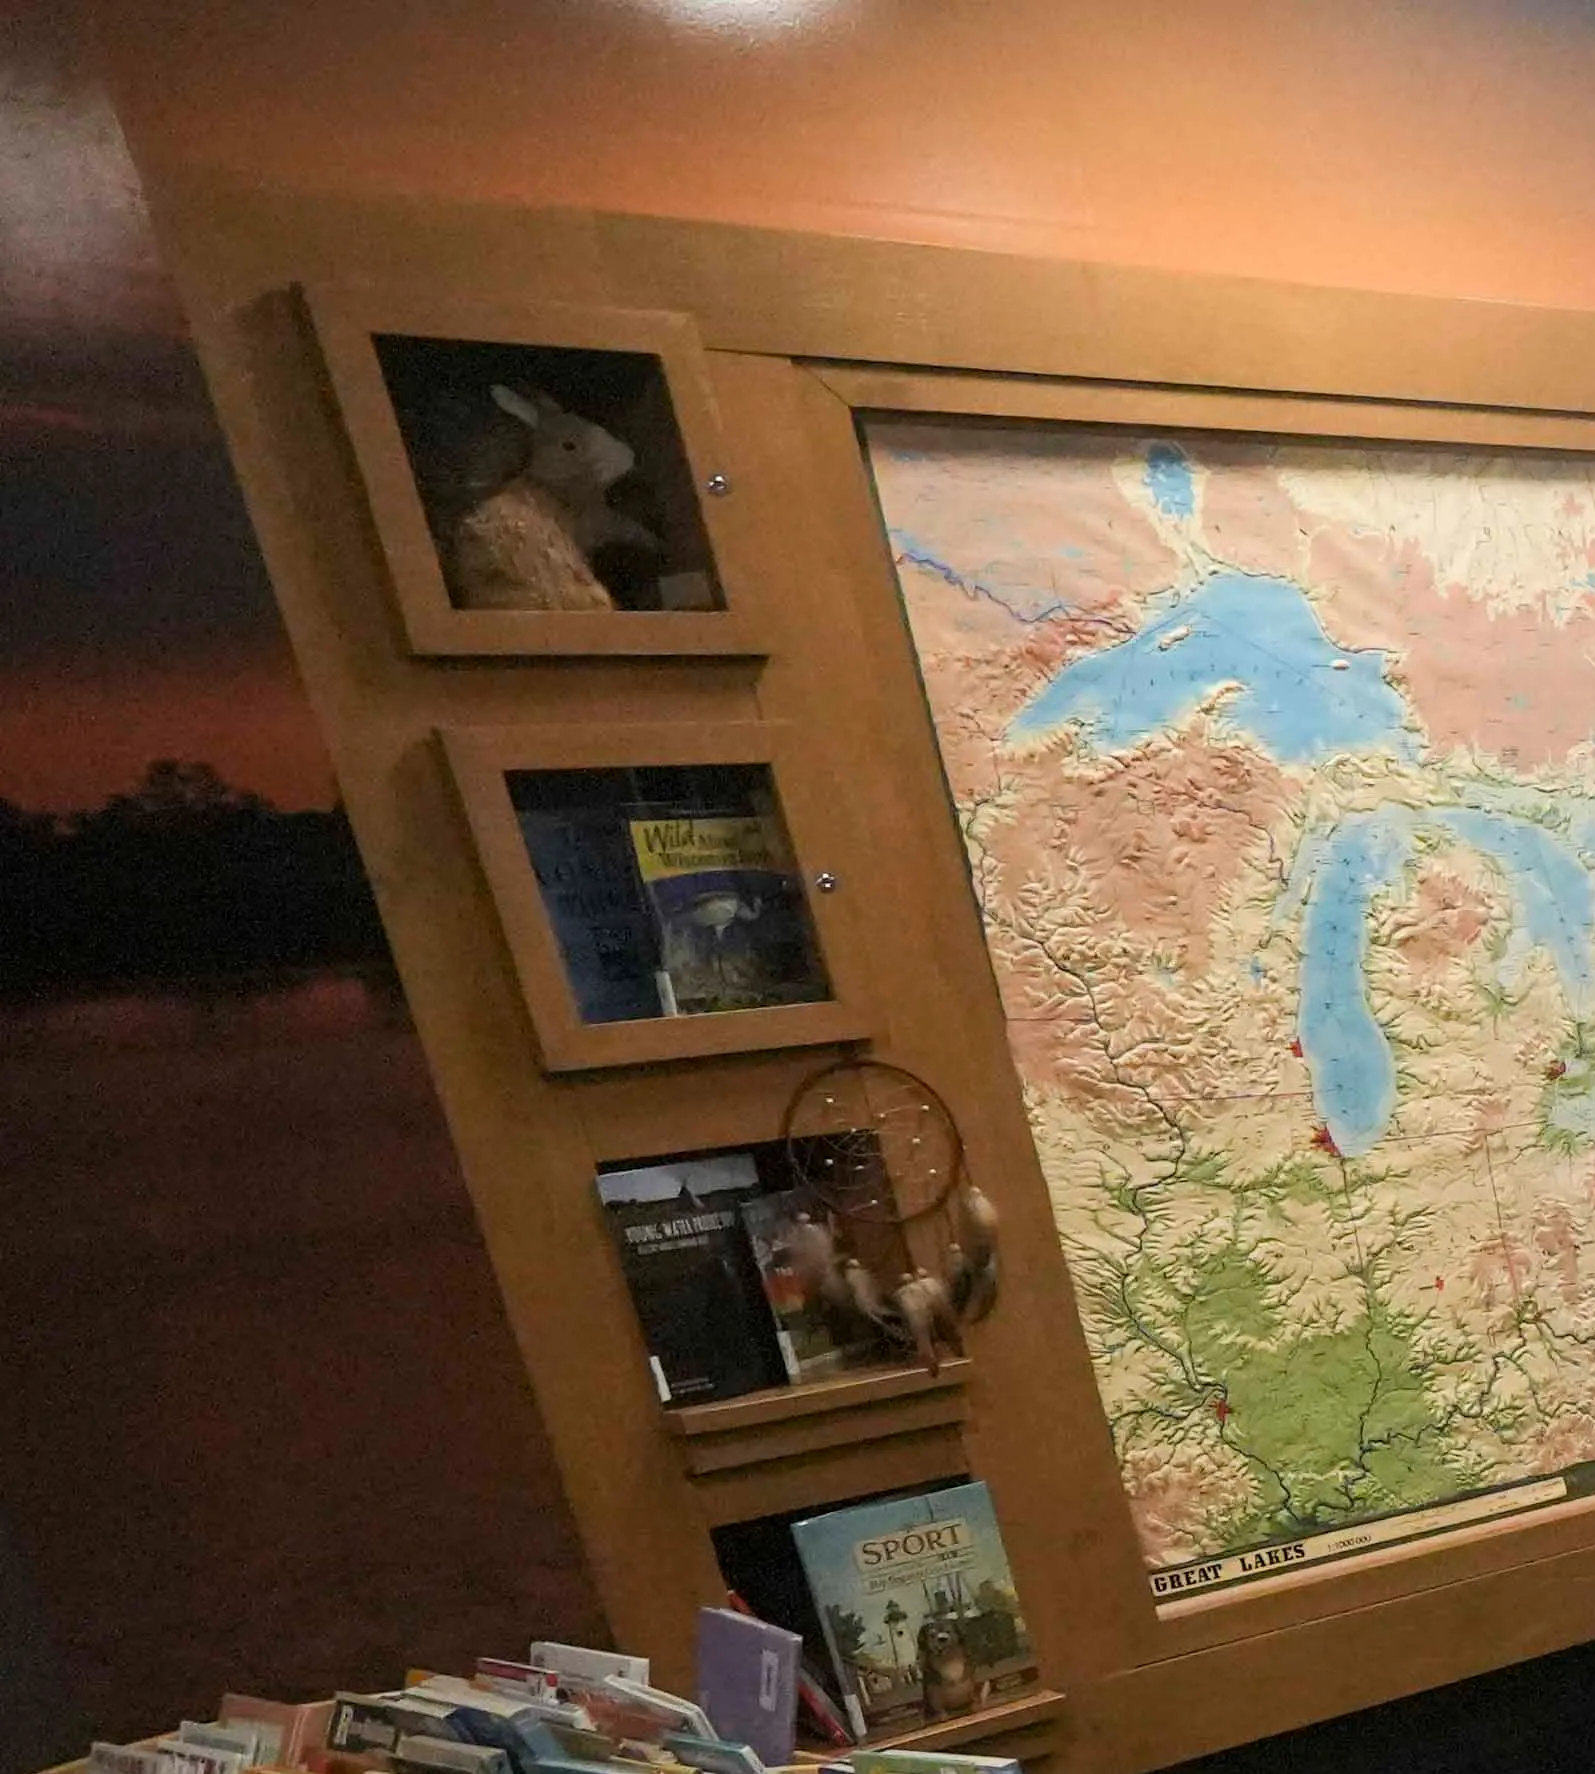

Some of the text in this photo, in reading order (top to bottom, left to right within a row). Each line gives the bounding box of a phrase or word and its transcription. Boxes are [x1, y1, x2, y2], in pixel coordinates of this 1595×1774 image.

[863, 1523, 961, 1565] SPORT
[1154, 1543, 1306, 1593] GREAT LAKES
